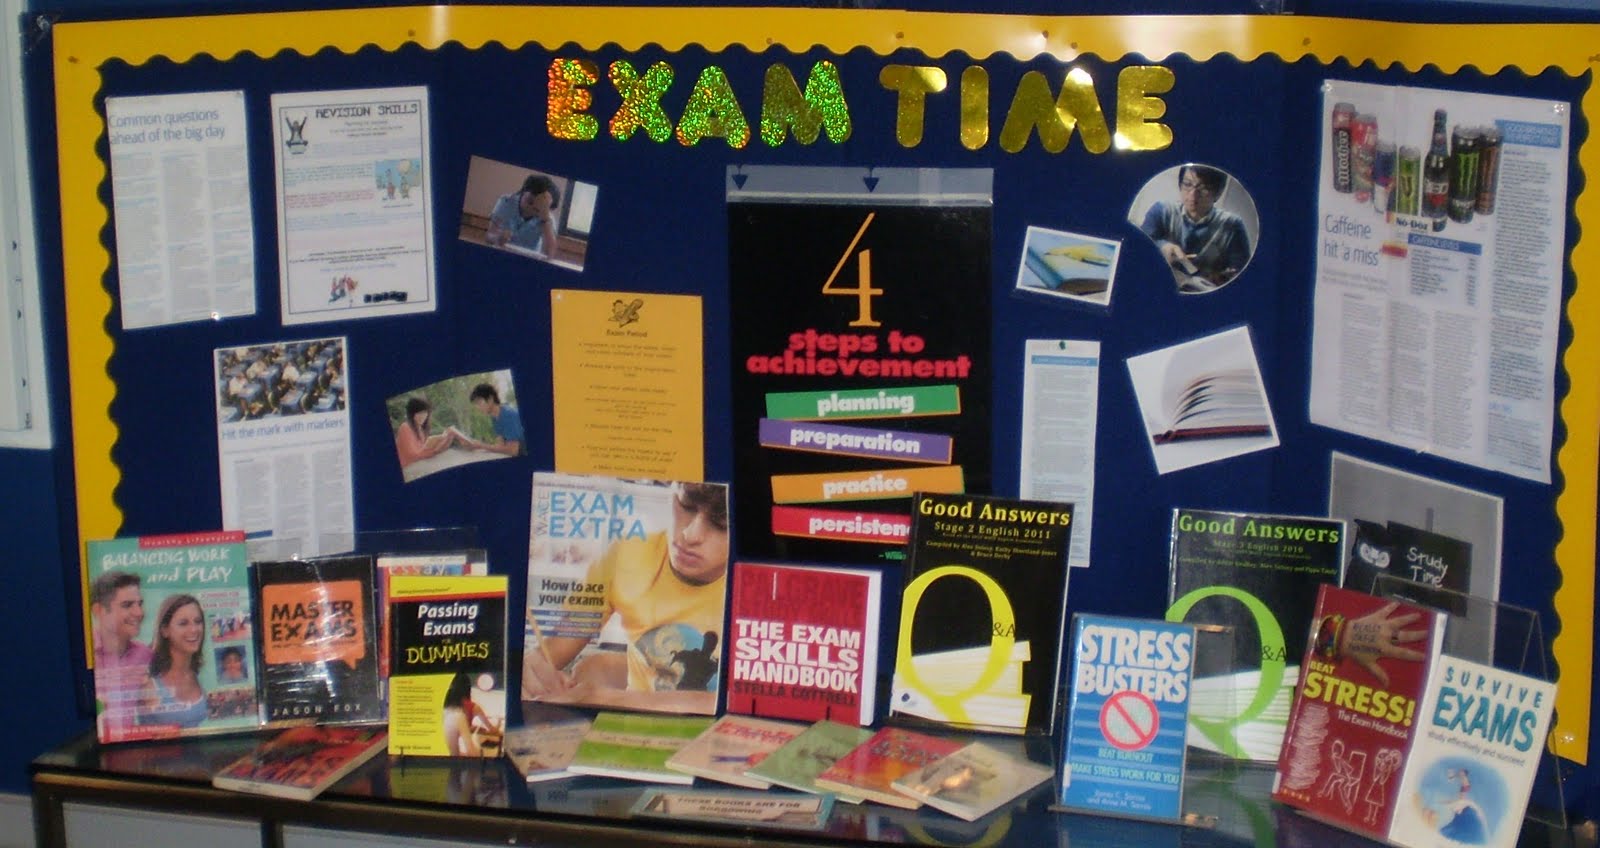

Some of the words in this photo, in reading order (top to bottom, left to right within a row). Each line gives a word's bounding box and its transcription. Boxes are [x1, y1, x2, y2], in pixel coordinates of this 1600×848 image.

[315, 106, 371, 119] REVISION
[378, 103, 418, 115] SKILLS
[546, 57, 852, 149] EXAM
[879, 64, 1176, 154] TIME
[109, 113, 161, 128] Common
[164, 110, 219, 126] questions
[111, 131, 145, 144] ahead
[149, 128, 161, 142] of
[163, 128, 181, 142] the
[185, 127, 202, 142] big
[205, 125, 225, 139] day
[1325, 214, 1372, 240] Caffeine
[1325, 238, 1338, 258] hit
[1354, 247, 1379, 267] miss
[822, 212, 883, 327] 4
[789, 329, 878, 356] steps
[888, 330, 925, 354] to
[746, 350, 971, 378] achievement
[817, 391, 915, 417] planning
[222, 428, 236, 441] Hit
[239, 427, 255, 439] the
[256, 424, 281, 437] mark
[284, 421, 305, 434] with
[307, 418, 345, 431] markers
[790, 428, 921, 454] preparation
[823, 474, 907, 500] practice
[536, 490, 550, 536] WACE
[550, 491, 634, 516] EXAM
[920, 498, 973, 518] Good
[979, 504, 1071, 526] Answers
[549, 516, 647, 541] EXTRA
[809, 516, 909, 537] persisten
[934, 521, 964, 534] Stage
[968, 524, 975, 533] 2
[979, 525, 1019, 537] English
[1024, 529, 1051, 539] 2011
[1179, 515, 1235, 535] Good
[1243, 520, 1339, 543] Answers
[102, 550, 183, 571] BALANCING
[188, 548, 230, 562] WORK
[1247, 542, 1279, 552] English
[147, 569, 179, 583] and
[186, 566, 233, 583] PLAY
[1407, 546, 1448, 577] Study
[542, 579, 569, 592] How
[571, 580, 583, 593] to
[585, 583, 604, 593] ace
[1410, 565, 1443, 591] Time
[271, 601, 354, 621] MASER
[418, 602, 478, 619] Passing
[539, 594, 566, 606] your
[568, 595, 604, 606] exams
[423, 621, 475, 637] Exams
[735, 619, 784, 640] THE
[792, 624, 861, 649] EXAM
[405, 641, 490, 664] DUMMIES
[735, 637, 859, 672] SKILLS
[1080, 625, 1191, 671] STRESS
[734, 660, 858, 694] HANDBOOK
[1310, 660, 1335, 674] BEAT
[734, 681, 785, 697] STELLA
[792, 688, 856, 706] COTTRELL
[1078, 663, 1187, 703] BUSTERS
[1445, 666, 1543, 708] SURVIVE
[272, 706, 322, 716] JASON
[334, 703, 361, 713] FOX
[1303, 671, 1416, 727] STRESS!
[1338, 709, 1350, 721] The
[1351, 714, 1371, 730] Exam
[1371, 719, 1408, 740] Handbook
[1432, 686, 1537, 752] EXAMS
[1098, 747, 1115, 759] BEAT
[1427, 731, 1445, 744] study
[1482, 748, 1496, 758] and
[1072, 763, 1092, 774] MAKE
[1094, 765, 1119, 777] STRESS
[1120, 768, 1145, 781] WORK
[1146, 771, 1161, 782] FOR
[1163, 773, 1180, 784] YOU
[715, 799, 751, 807] BOOKS
